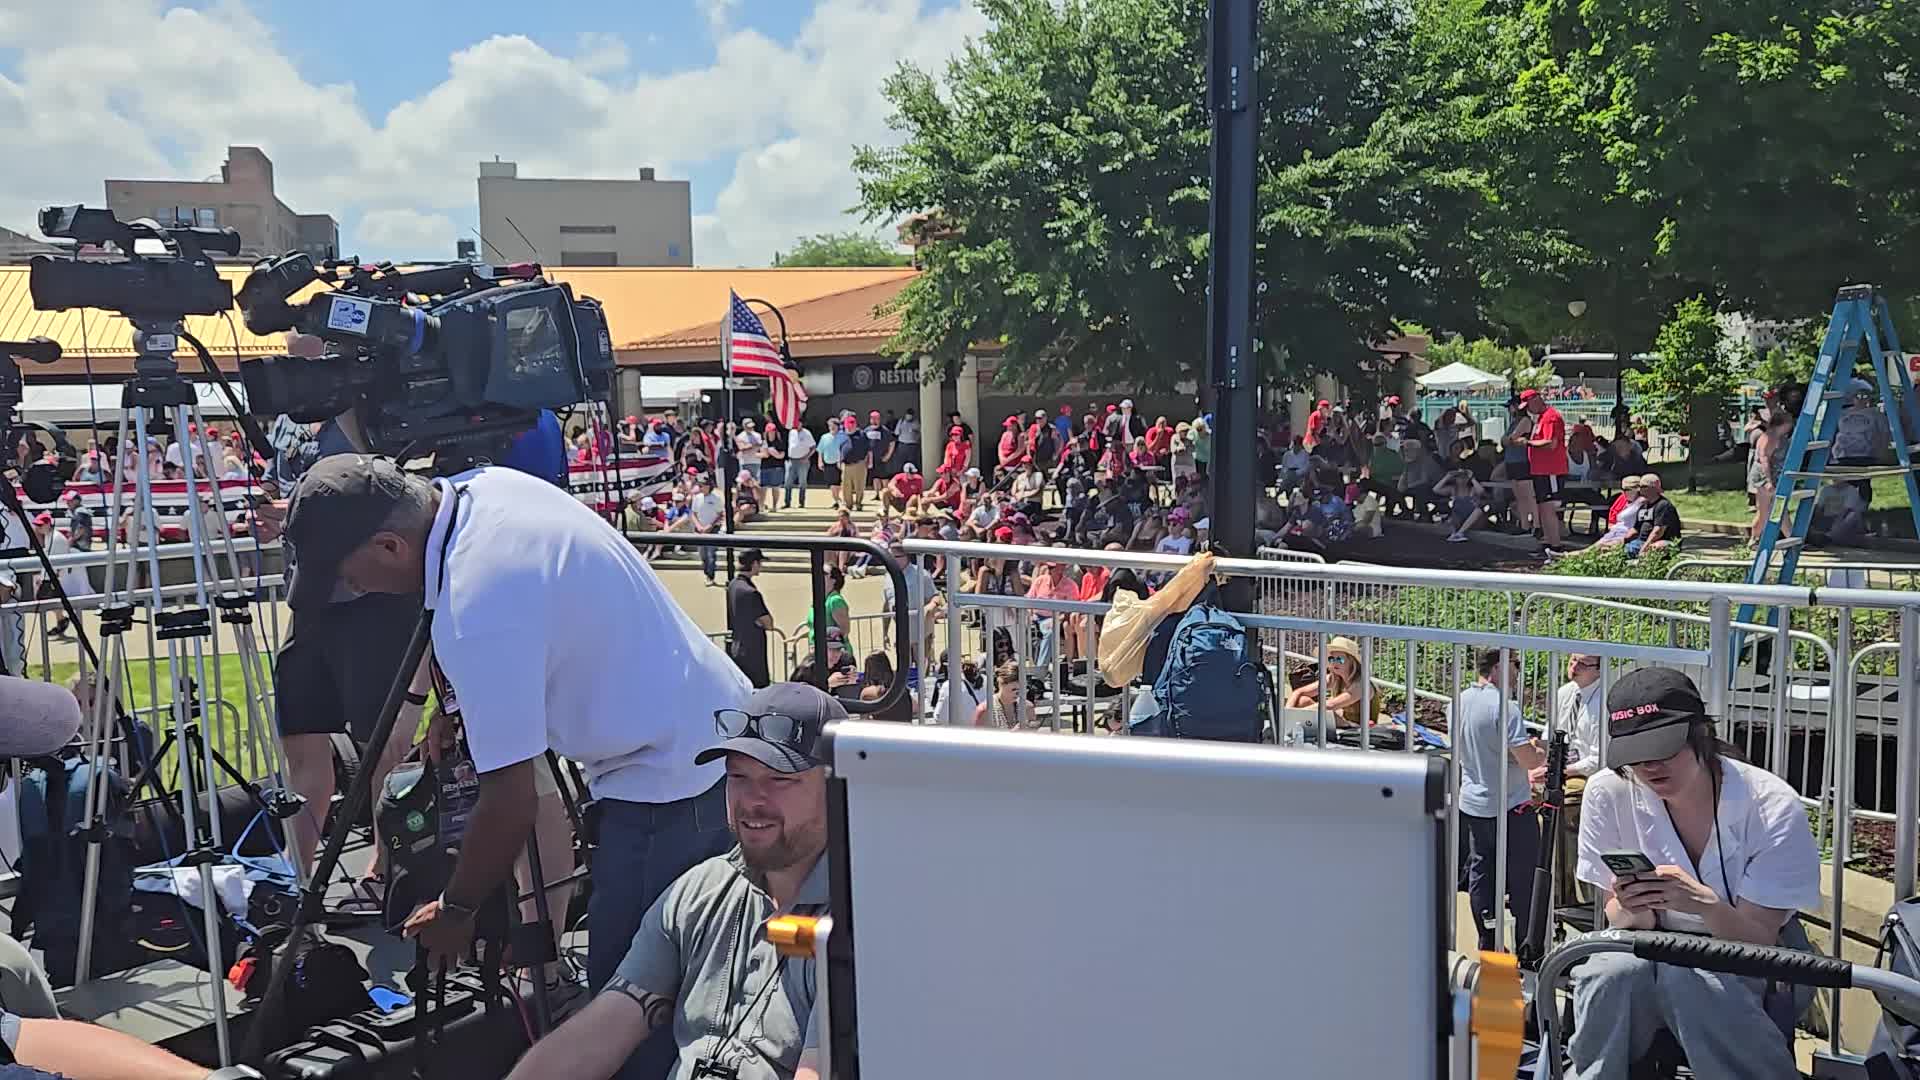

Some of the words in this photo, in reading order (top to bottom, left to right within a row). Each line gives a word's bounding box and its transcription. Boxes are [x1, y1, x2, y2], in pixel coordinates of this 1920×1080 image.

[880, 367, 946, 384] RESTROS
[1636, 703, 1659, 715] BOX
[391, 836, 402, 849] 2
